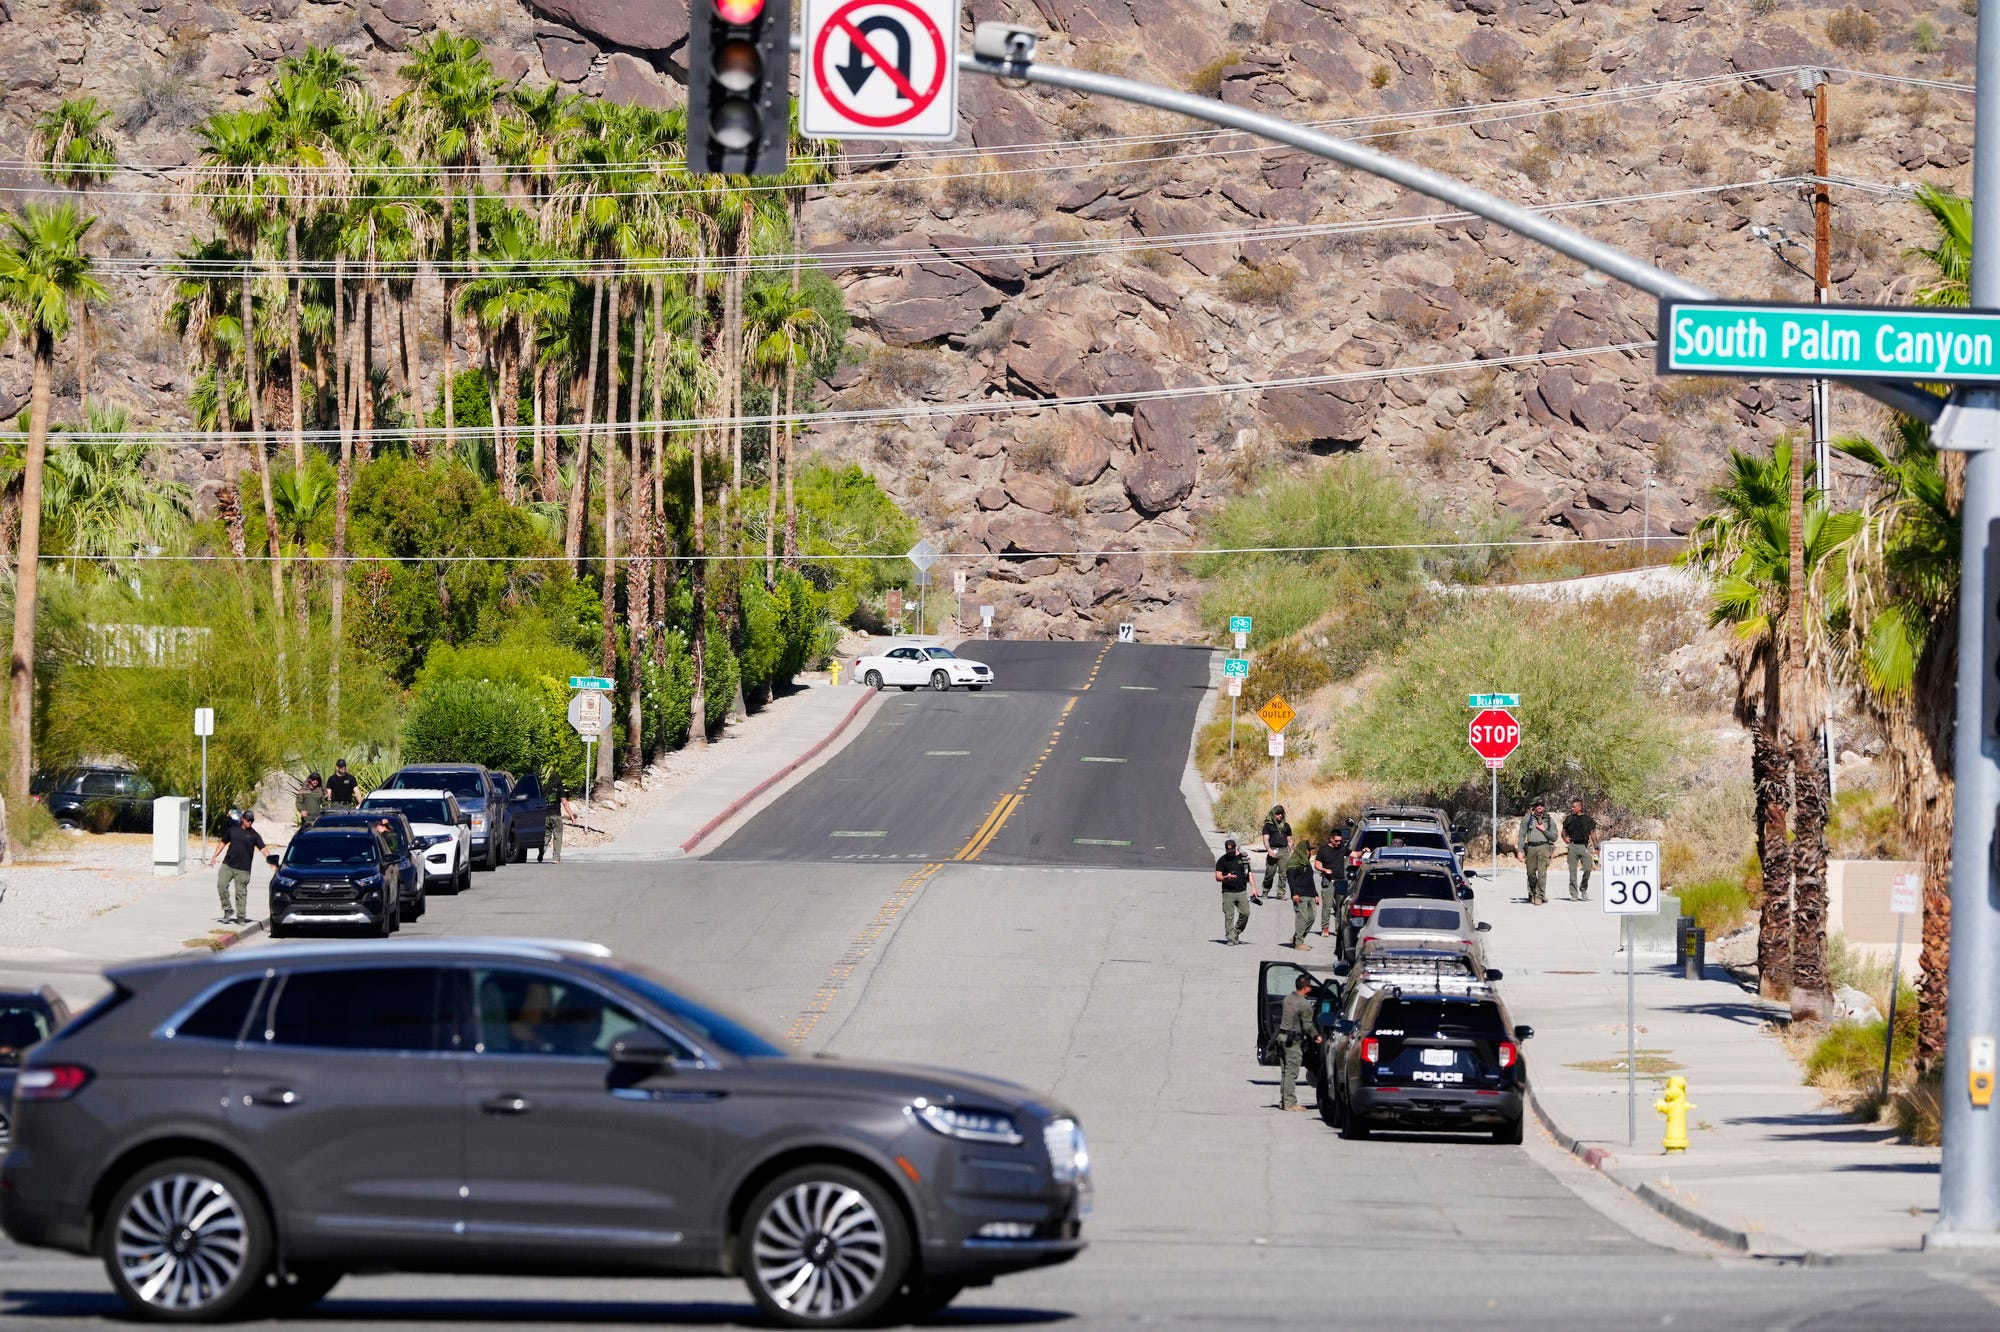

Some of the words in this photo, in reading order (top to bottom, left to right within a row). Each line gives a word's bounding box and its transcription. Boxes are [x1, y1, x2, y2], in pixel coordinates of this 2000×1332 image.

[1676, 317, 1767, 358] South
[1781, 320, 1860, 362] Palm
[1875, 324, 1993, 373] Canyon
[1262, 710, 1292, 719] OUTLET
[1471, 725, 1518, 744] STOP
[1607, 851, 1654, 862] SPEED
[1612, 865, 1648, 877] LIMIT
[1610, 880, 1652, 905] 30
[1412, 1071, 1464, 1083] POLICE
